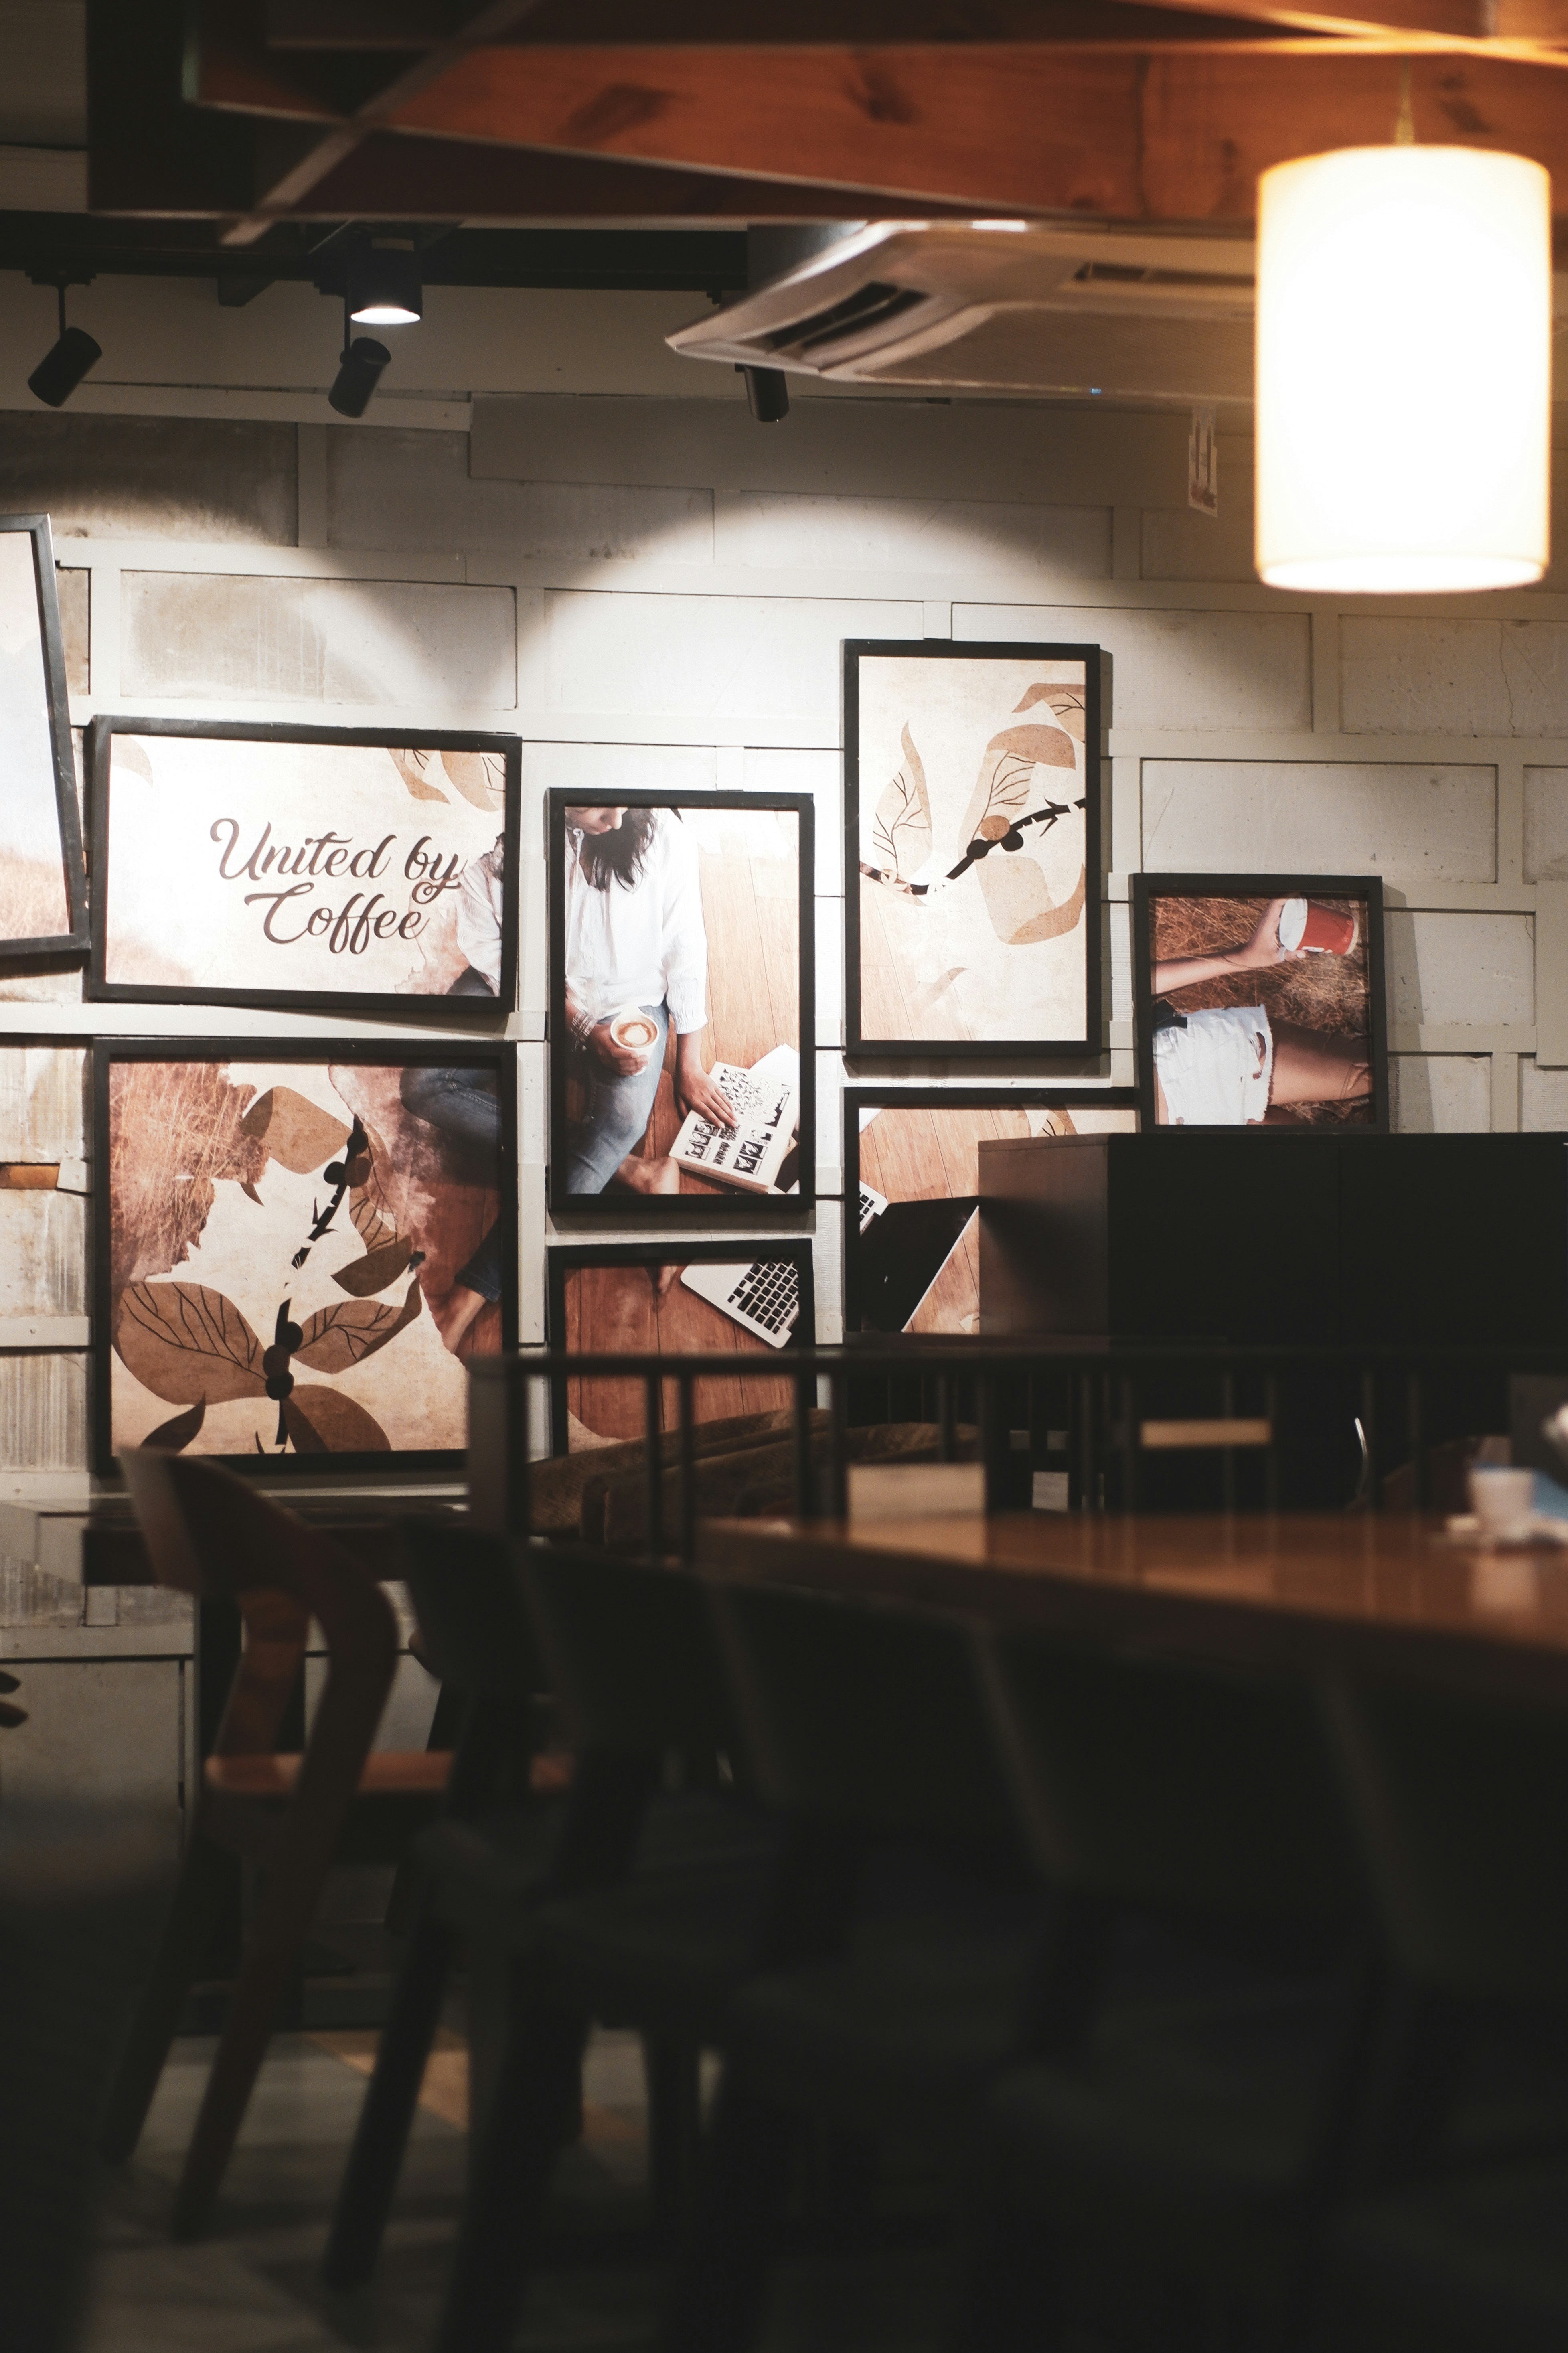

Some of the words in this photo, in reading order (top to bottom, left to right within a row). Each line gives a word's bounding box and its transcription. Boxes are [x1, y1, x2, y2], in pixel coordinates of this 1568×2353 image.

[210, 818, 397, 880] United
[404, 836, 467, 904] by
[244, 882, 430, 954] Coffee
